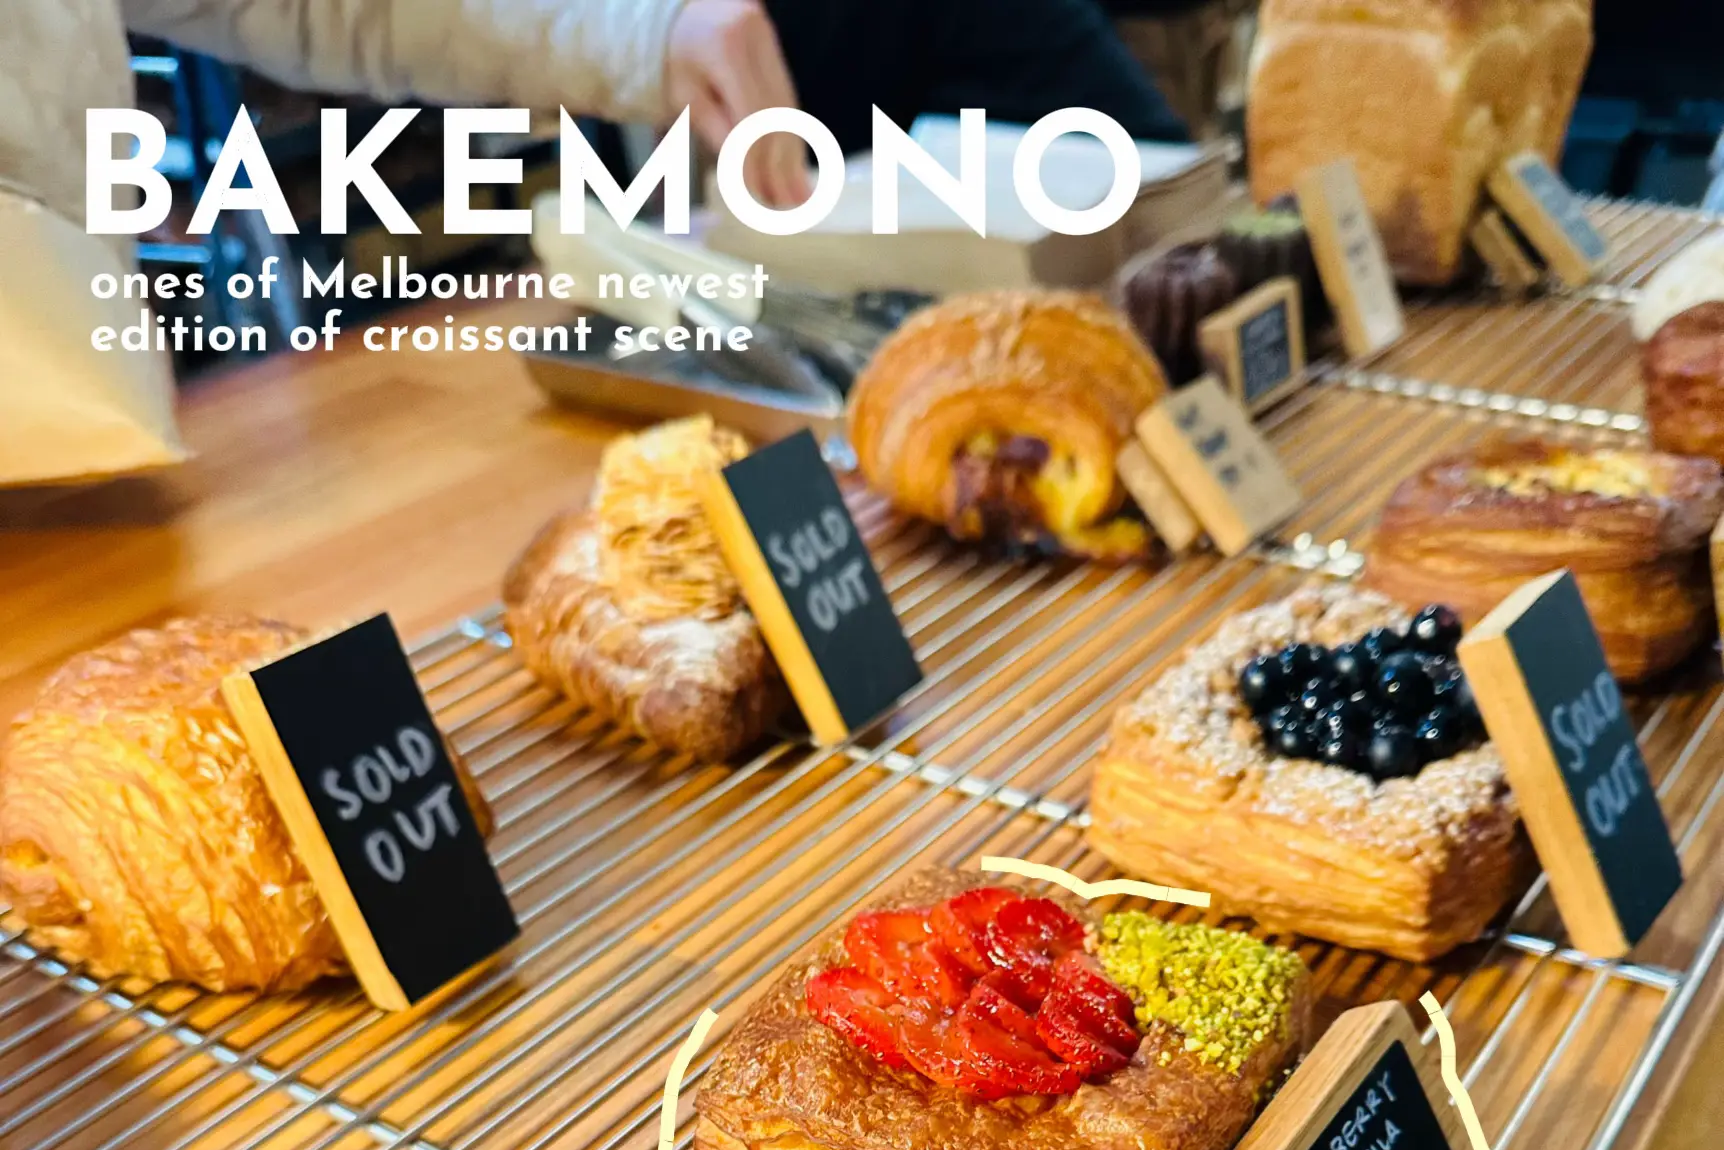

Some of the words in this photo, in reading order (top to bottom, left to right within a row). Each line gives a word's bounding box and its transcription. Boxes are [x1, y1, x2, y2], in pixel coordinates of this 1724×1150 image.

[767, 506, 850, 590] SOLD
[805, 557, 870, 632] OUT
[1551, 670, 1621, 773] SOLD
[322, 726, 435, 822] SOLD
[1584, 743, 1640, 838] OUT
[363, 782, 462, 884] OUT
